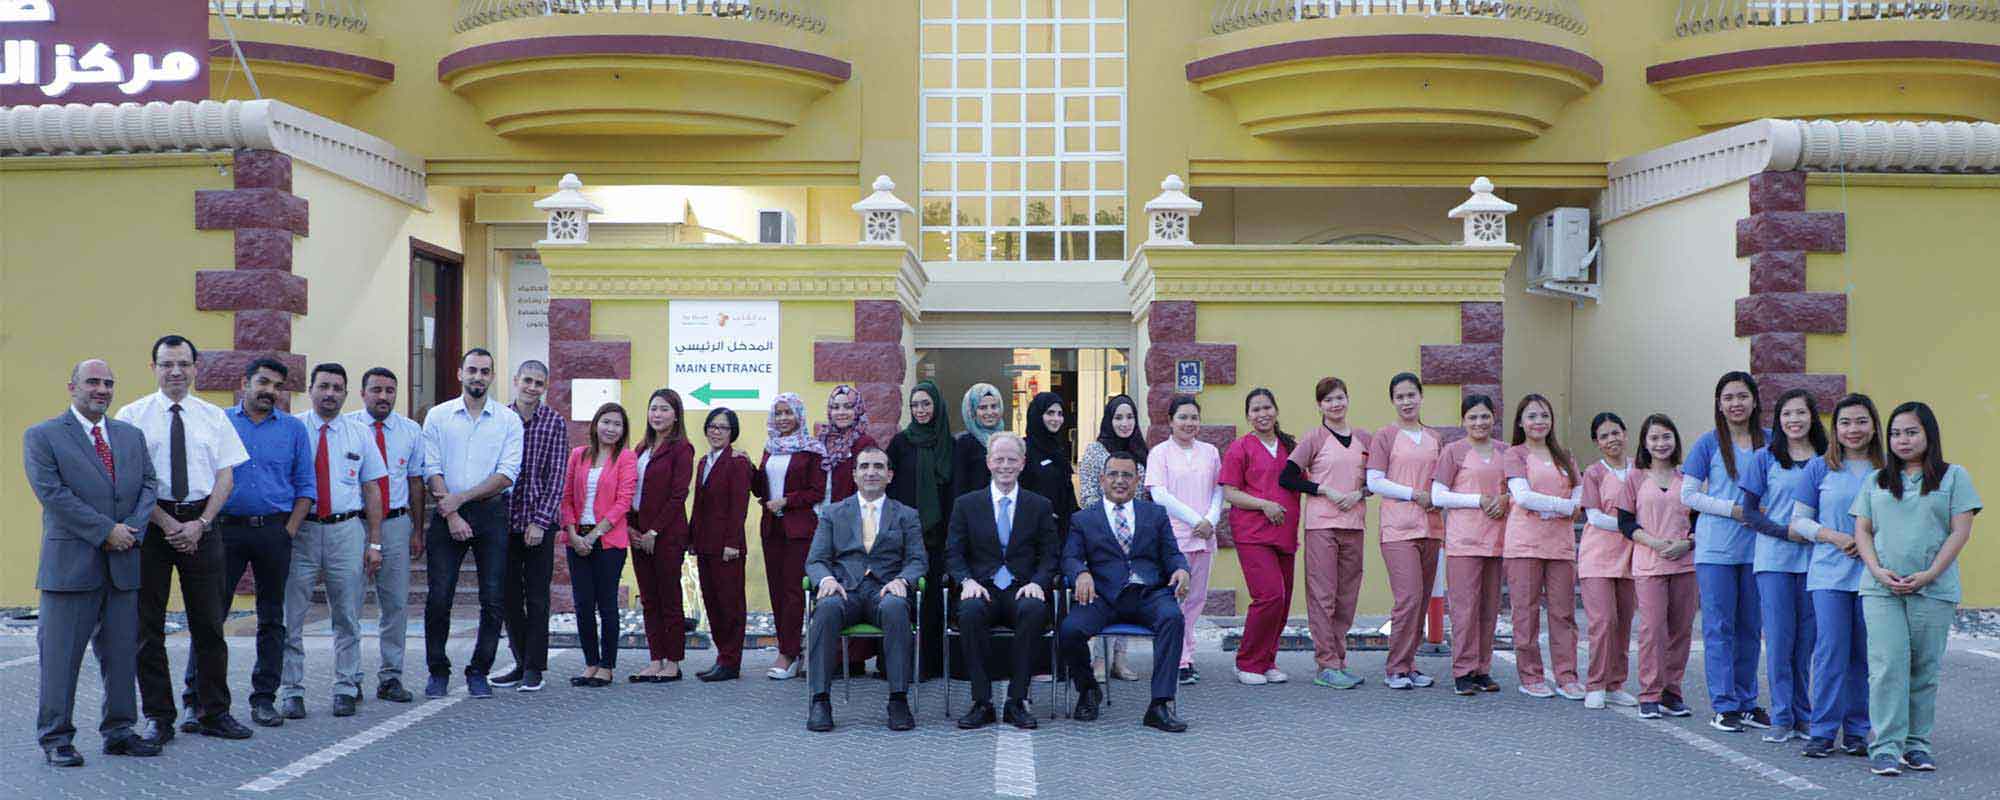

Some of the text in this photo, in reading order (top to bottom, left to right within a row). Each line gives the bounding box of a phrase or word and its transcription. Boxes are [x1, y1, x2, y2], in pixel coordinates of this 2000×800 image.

[40, 43, 200, 97] مركز
[675, 340, 773, 356] المدخل الرئيسي
[675, 363, 773, 374] MAIN ENTRANCE
[1180, 375, 1198, 386] 36
